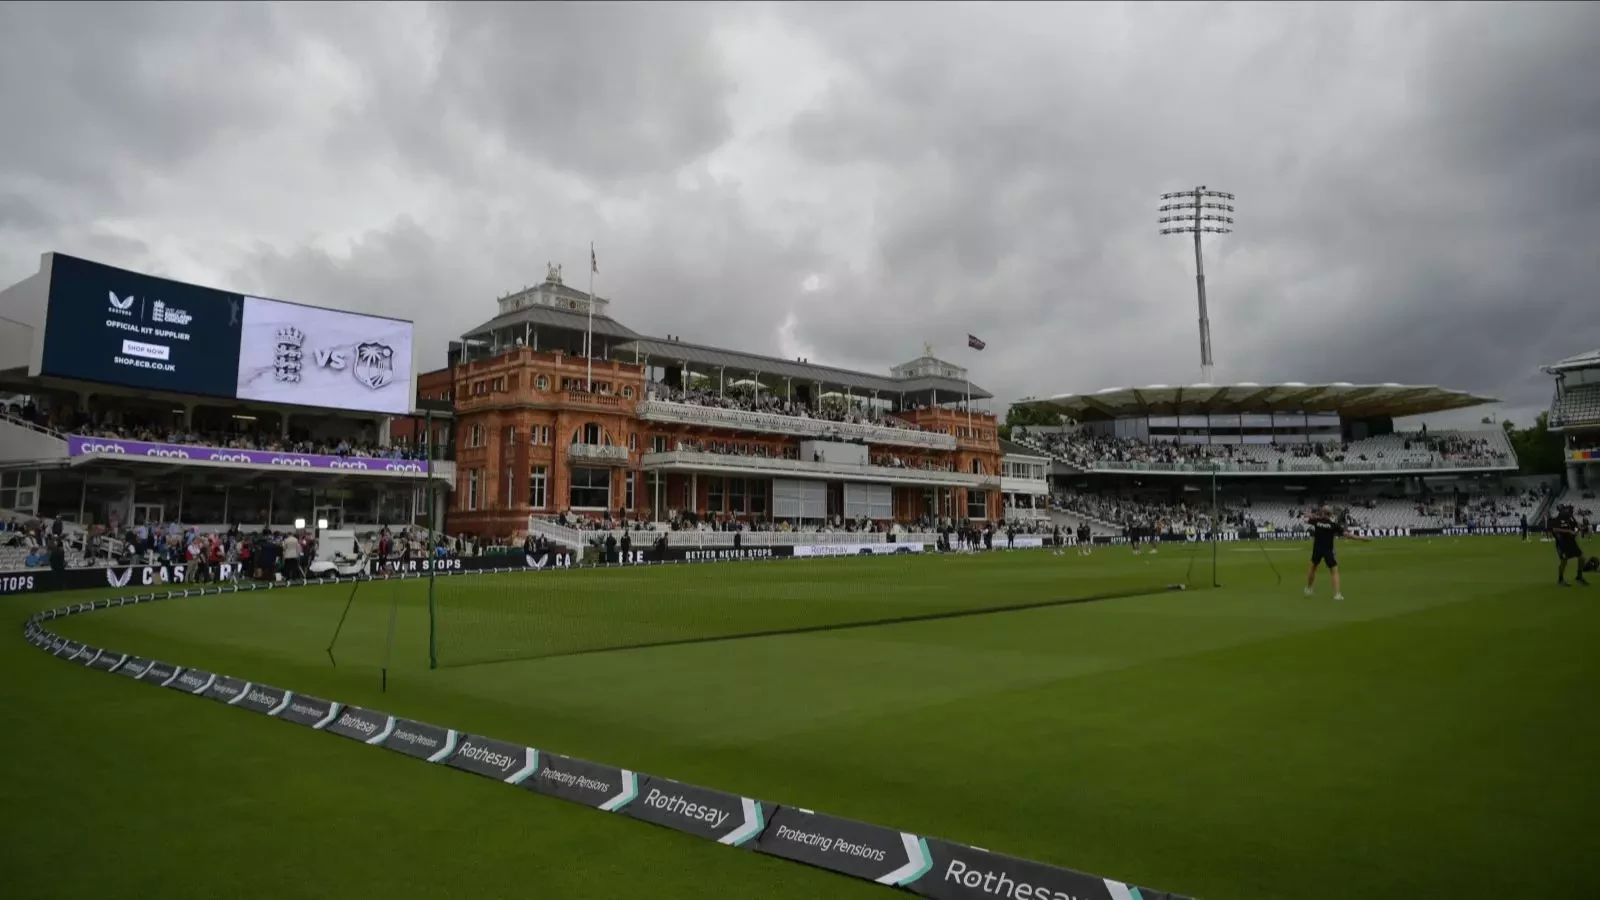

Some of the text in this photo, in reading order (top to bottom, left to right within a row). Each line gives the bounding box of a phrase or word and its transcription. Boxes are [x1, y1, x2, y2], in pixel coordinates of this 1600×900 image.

[105, 319, 191, 341] OFFICIAL KIT SUPPLIER
[127, 344, 165, 355] SHOP NOW
[313, 348, 346, 370] VS
[113, 356, 176, 372] SHOP.ECB.CO.UK
[685, 548, 773, 560] BETTER NEVER STOPS
[338, 713, 379, 736] Rothesay
[458, 741, 517, 772] Rothesay
[540, 766, 610, 794] Protecting Pensions
[643, 787, 730, 829] Rothesay
[776, 824, 887, 863] Protecting Pensions
